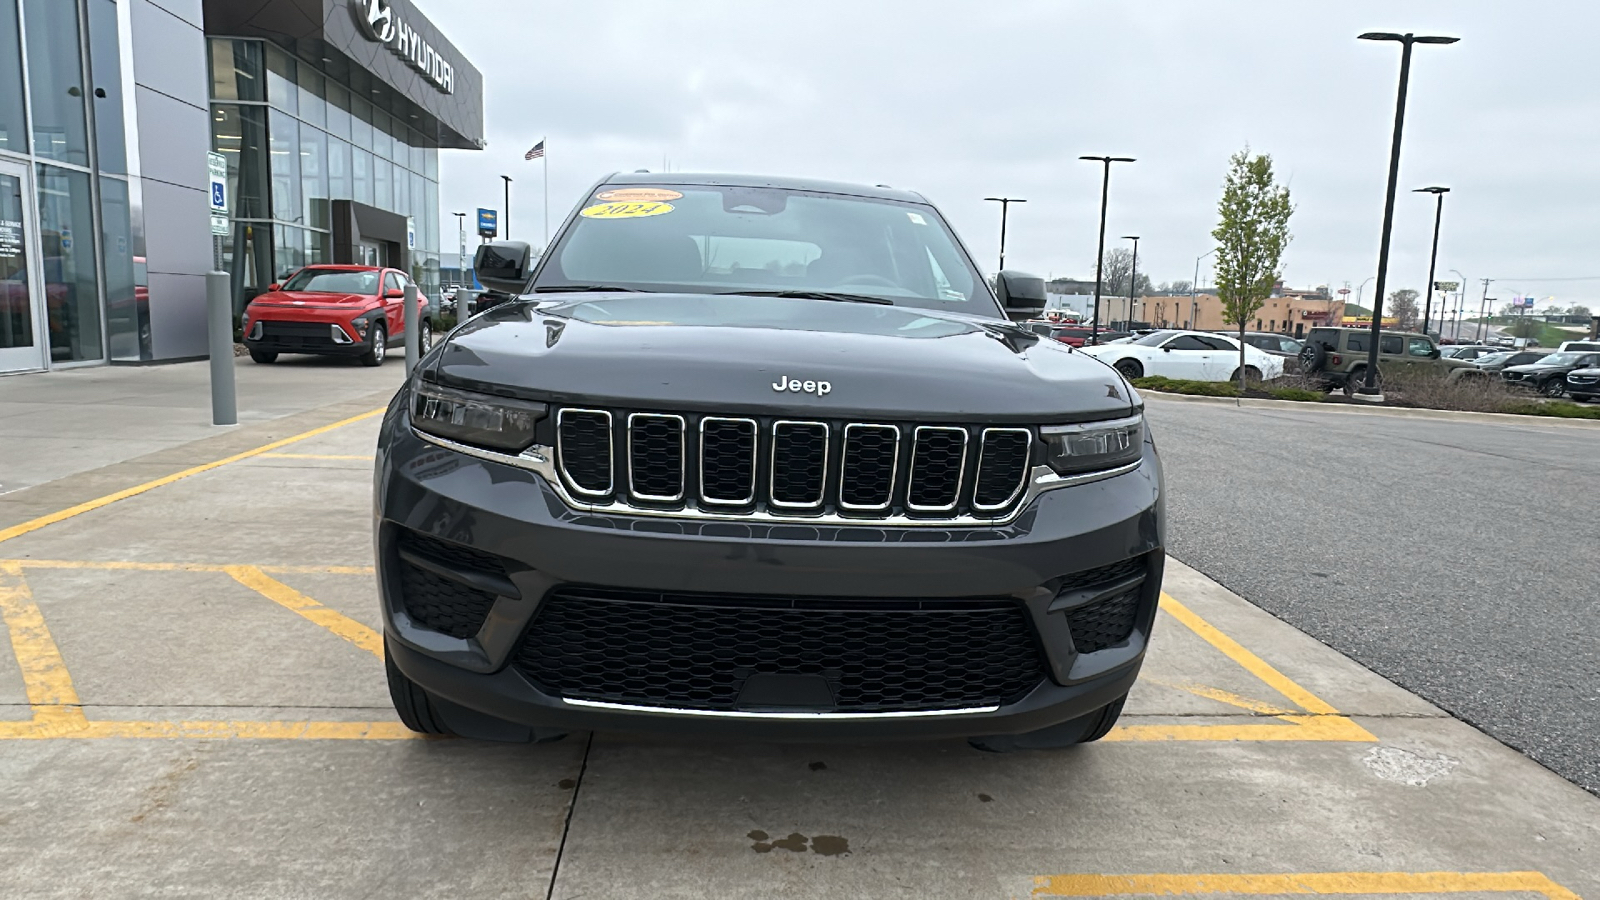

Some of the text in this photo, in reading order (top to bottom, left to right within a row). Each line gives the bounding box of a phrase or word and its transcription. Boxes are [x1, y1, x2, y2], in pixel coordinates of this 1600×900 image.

[397, 16, 455, 95] HYUNDAI
[593, 204, 662, 215] 2024
[772, 375, 832, 396] Jeep
